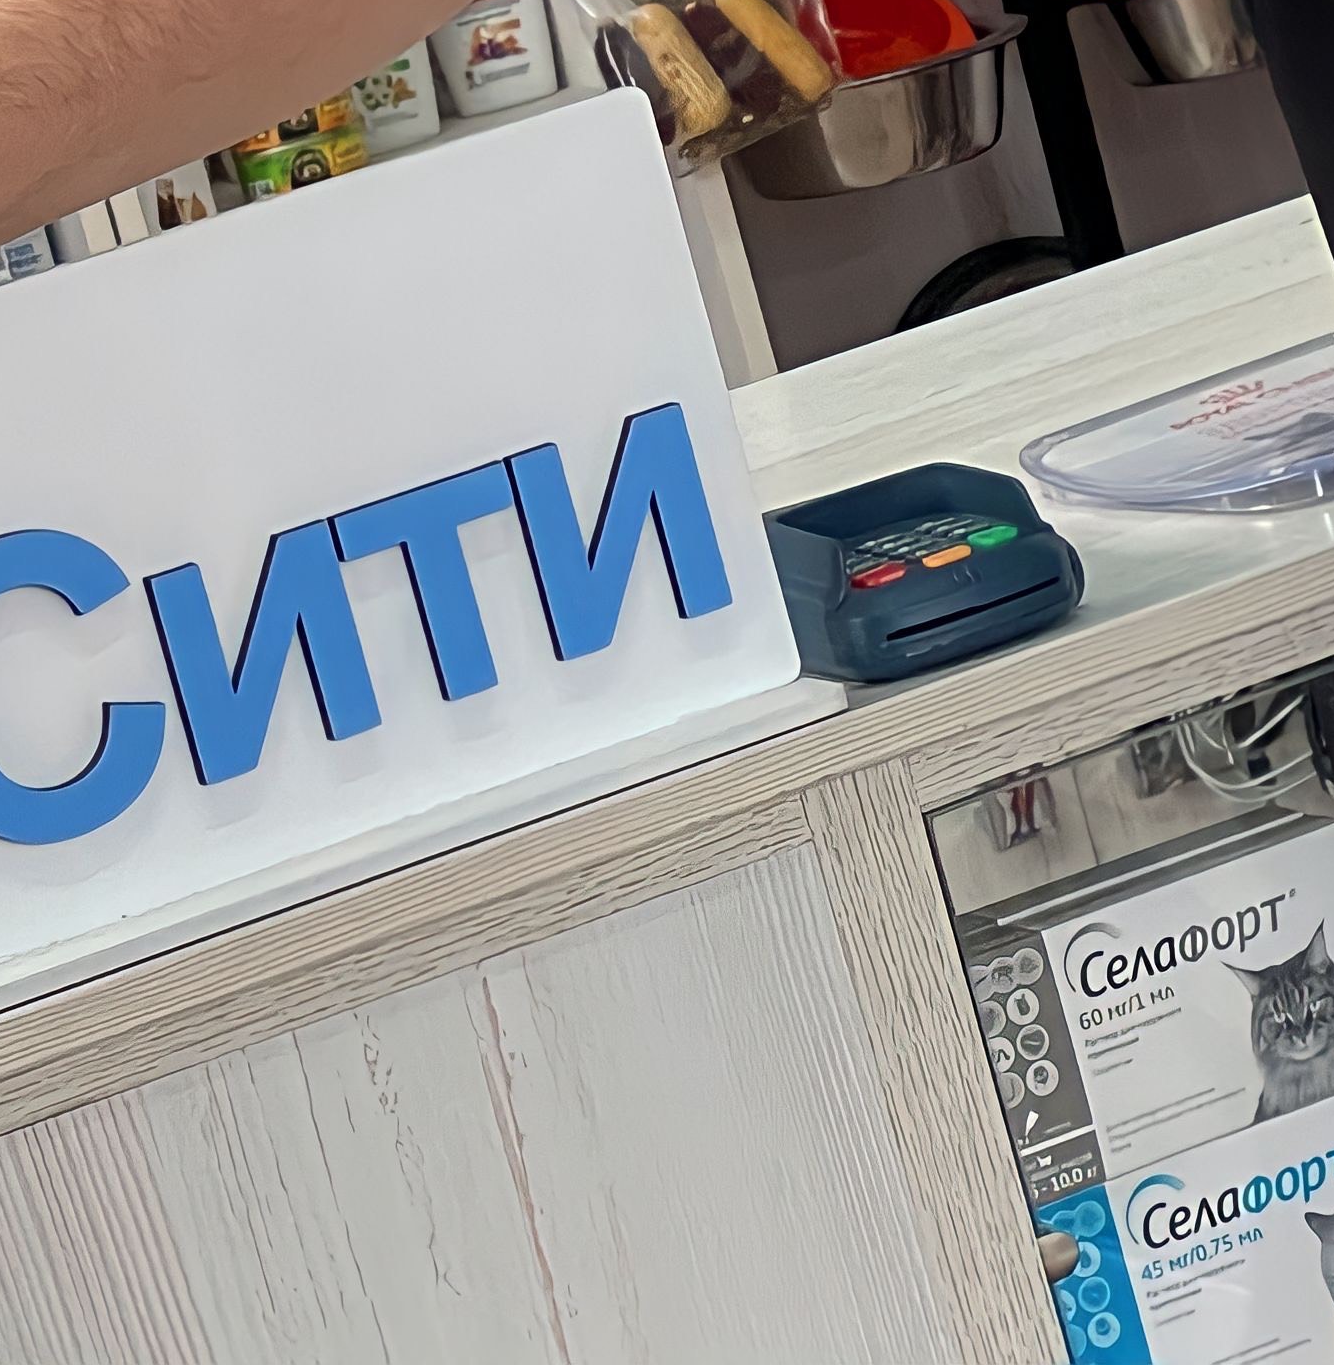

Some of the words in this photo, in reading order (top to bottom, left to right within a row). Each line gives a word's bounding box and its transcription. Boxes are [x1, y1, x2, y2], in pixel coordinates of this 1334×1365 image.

[1080, 893, 1288, 999] Селафорт
[1079, 1007, 1104, 1031] 60
[1150, 985, 1176, 1005] мл
[1141, 1259, 1165, 1281] 45
[1238, 1226, 1265, 1247] мл
